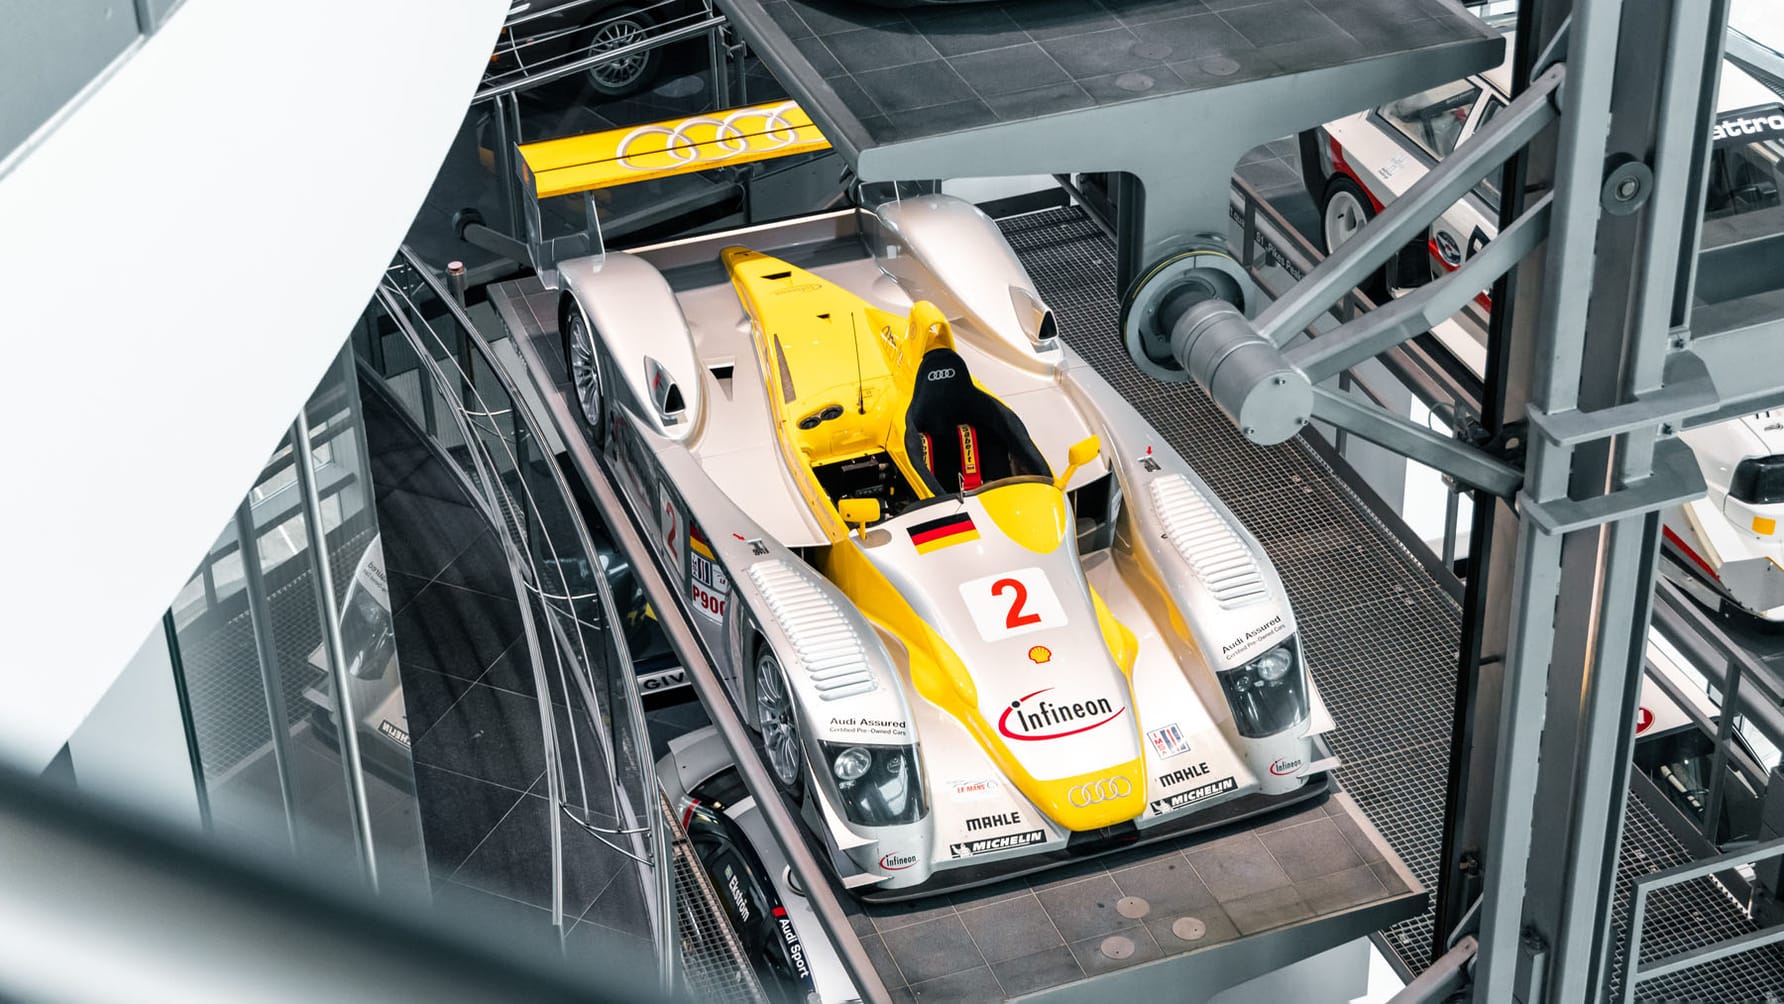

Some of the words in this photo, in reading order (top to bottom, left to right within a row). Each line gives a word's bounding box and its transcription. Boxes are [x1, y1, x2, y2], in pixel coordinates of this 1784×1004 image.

[666, 502, 678, 560] 2
[991, 578, 1042, 629] 2
[1222, 638, 1244, 654] Audi
[1245, 615, 1281, 640] Assured
[830, 717, 856, 725] Audi
[860, 718, 906, 729] Assured
[1159, 762, 1210, 788] MAHLE
[1171, 779, 1233, 806] MICHELIN
[966, 811, 1021, 832] MAHLE
[972, 832, 1043, 851] MICHELIN
[728, 875, 750, 923] Ekström
[779, 919, 796, 944] Audi
[790, 943, 810, 979] Sport
